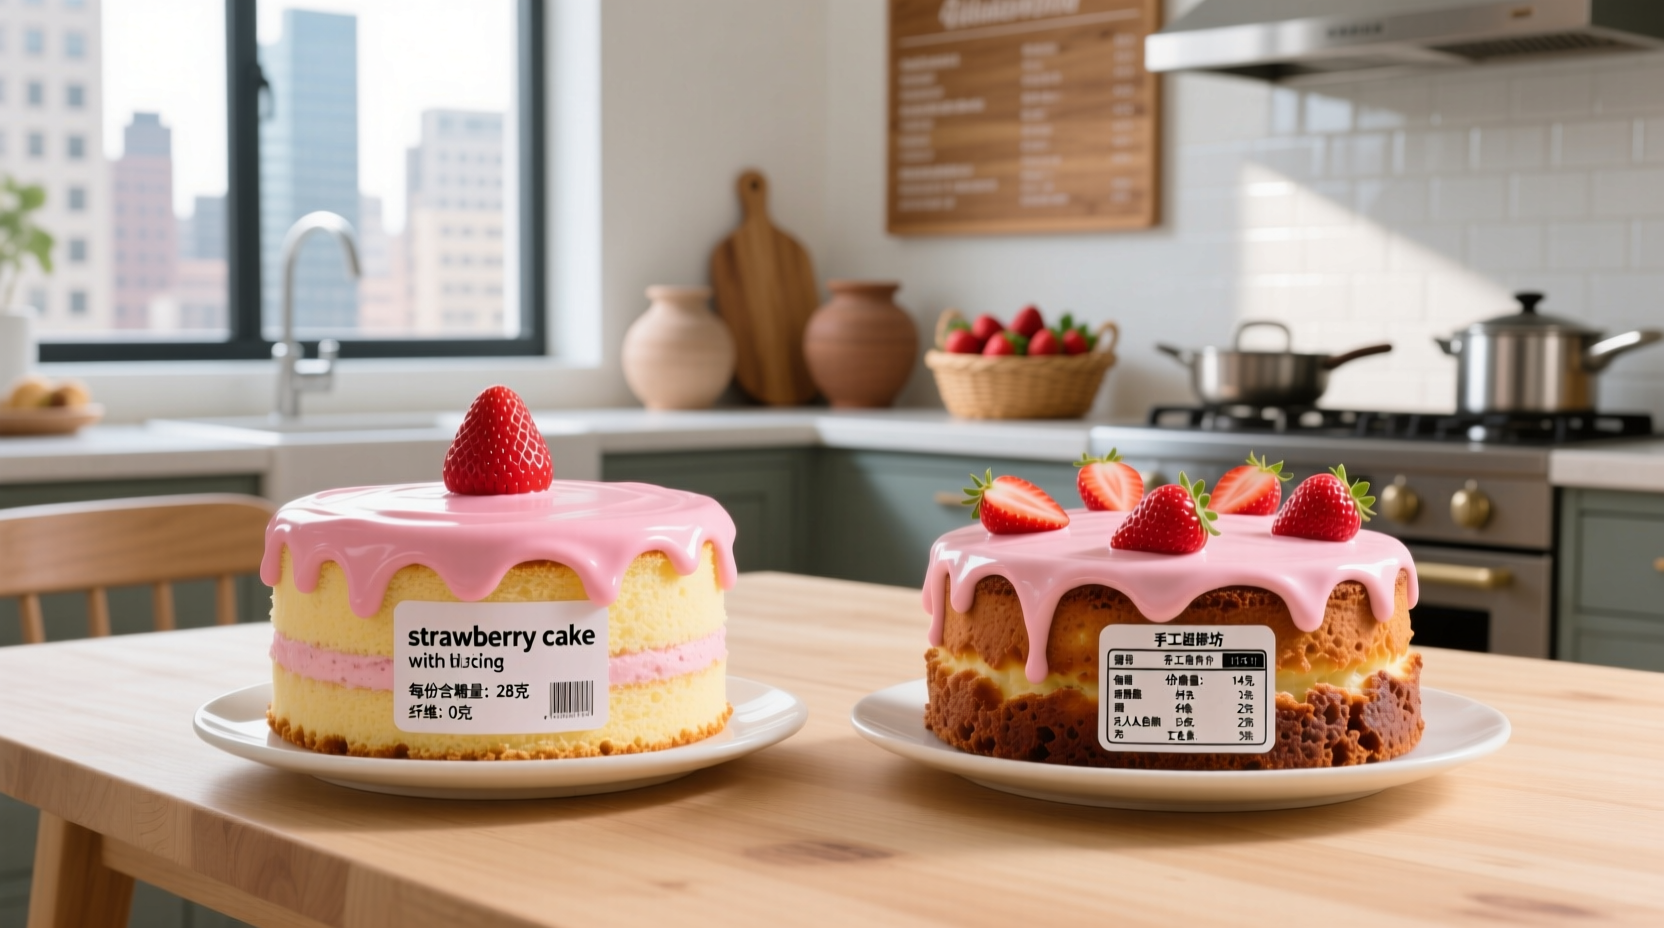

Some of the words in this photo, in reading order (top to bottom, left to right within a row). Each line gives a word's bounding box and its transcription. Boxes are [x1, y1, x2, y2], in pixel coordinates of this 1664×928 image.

[408, 625, 536, 652] strawberry
[542, 624, 595, 646] cake
[408, 653, 445, 668] with
